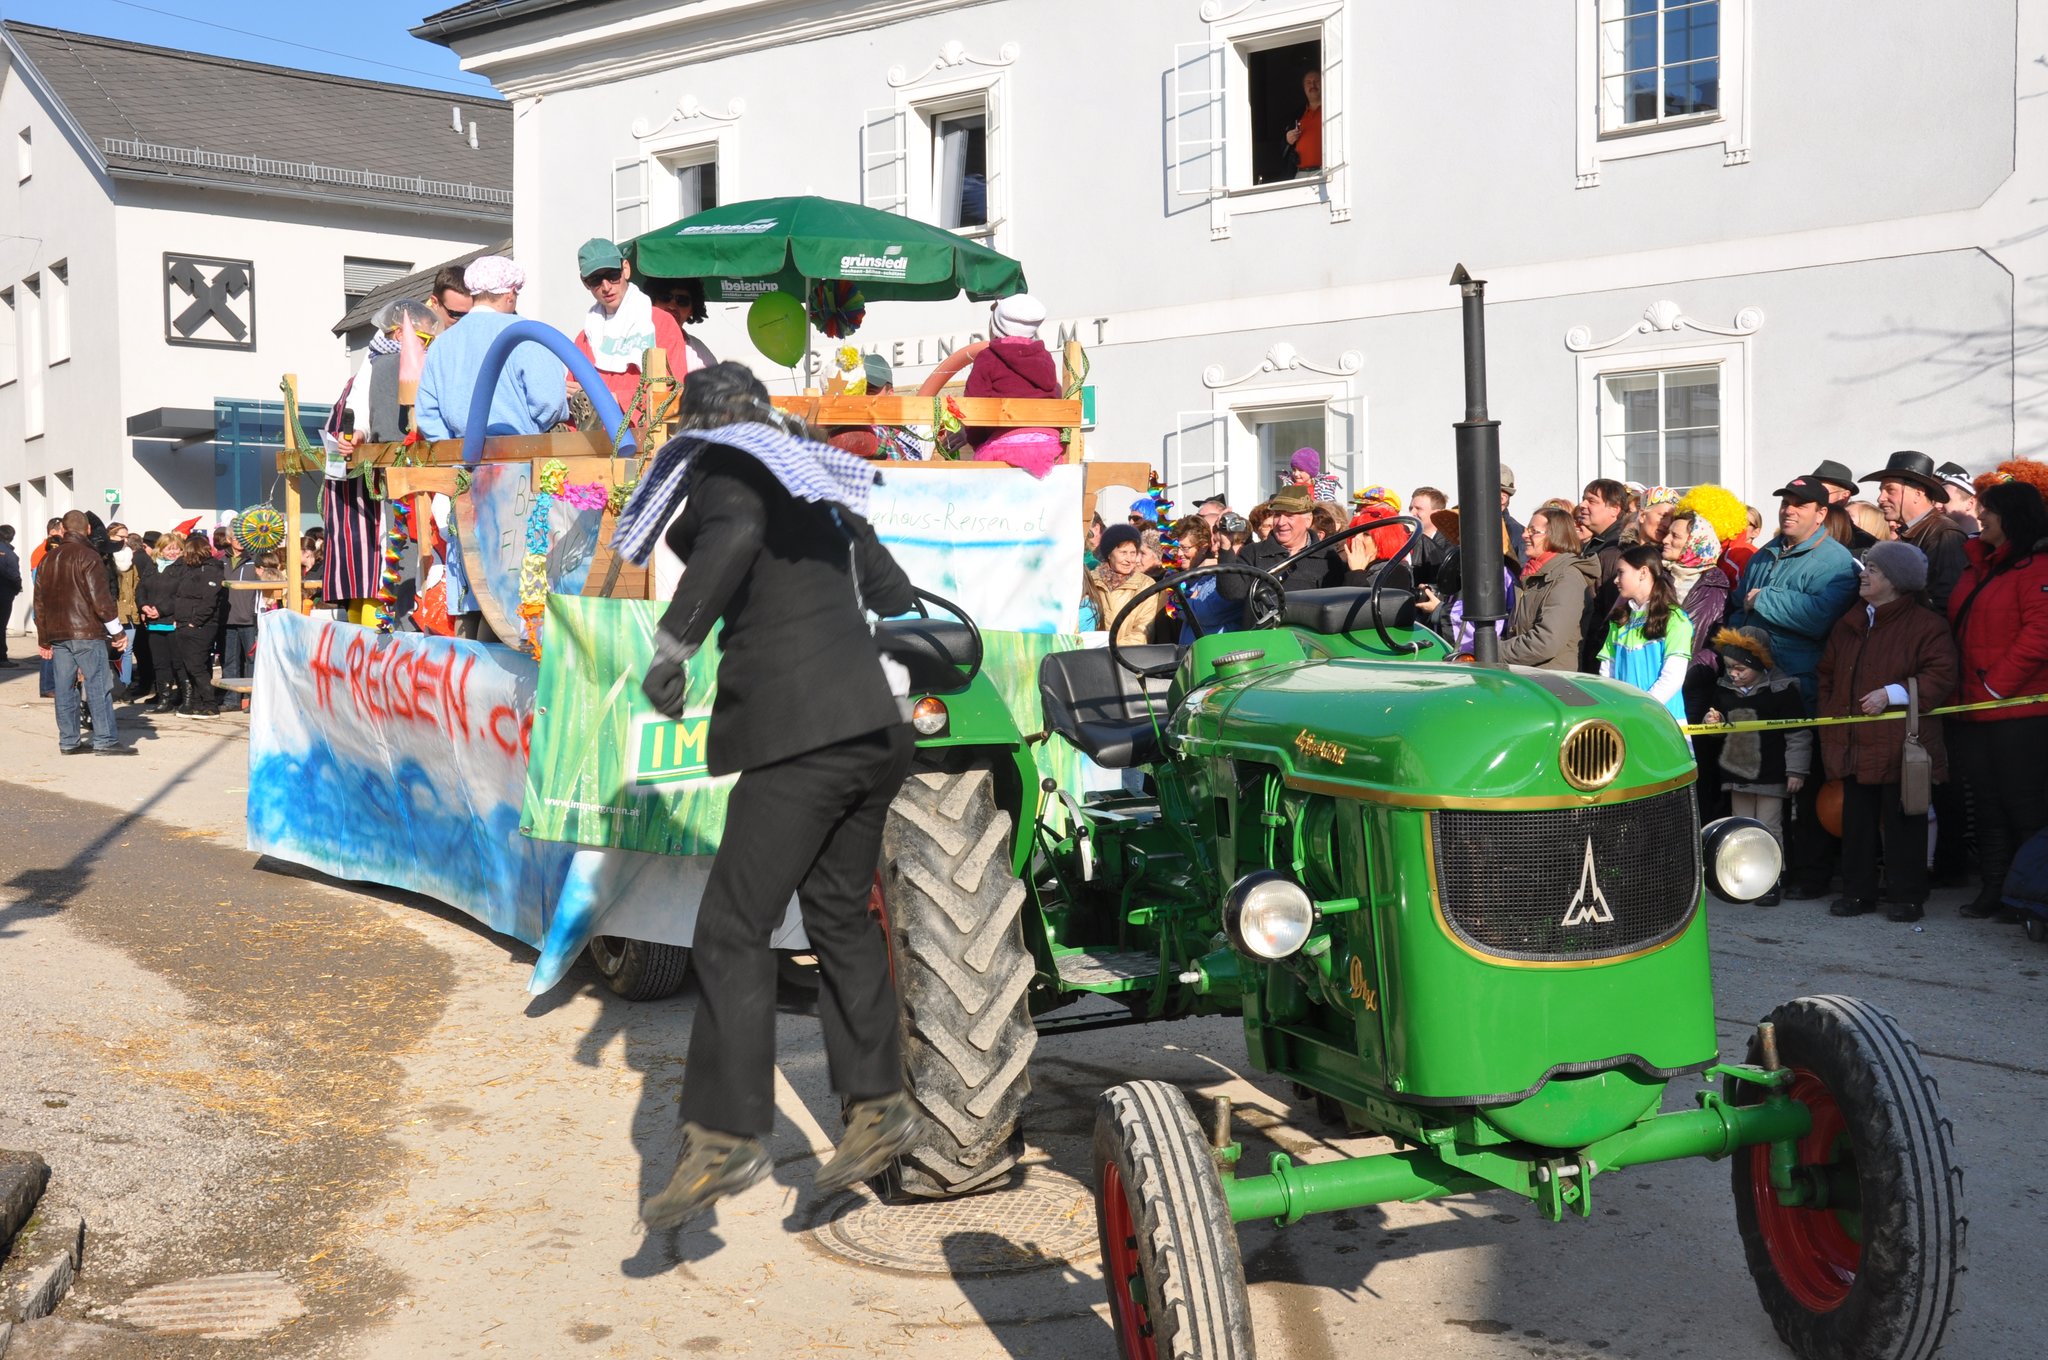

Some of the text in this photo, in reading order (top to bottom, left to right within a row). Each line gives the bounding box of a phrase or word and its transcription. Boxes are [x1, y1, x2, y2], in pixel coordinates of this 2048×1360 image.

[840, 253, 908, 269] grünsiedl
[802, 317, 1110, 375] GEINDMT
[544, 797, 640, 817] www.immergruen.at
